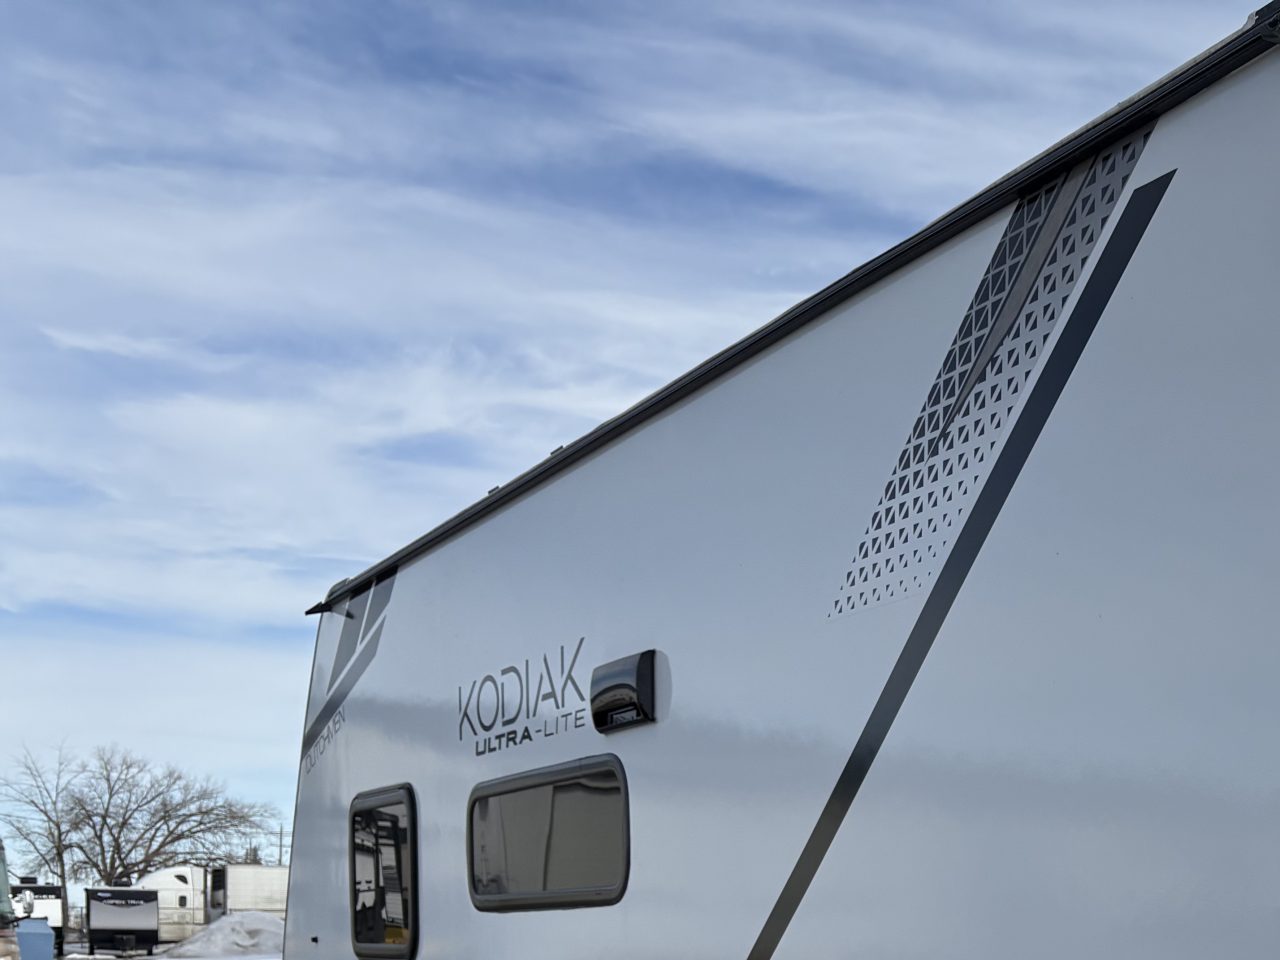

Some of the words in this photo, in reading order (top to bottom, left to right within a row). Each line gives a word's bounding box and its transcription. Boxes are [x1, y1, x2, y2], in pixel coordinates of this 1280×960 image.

[458, 637, 586, 740] KODIAK
[305, 708, 346, 775] DUTCHMEN
[475, 708, 586, 756] ULTRA-LITE
